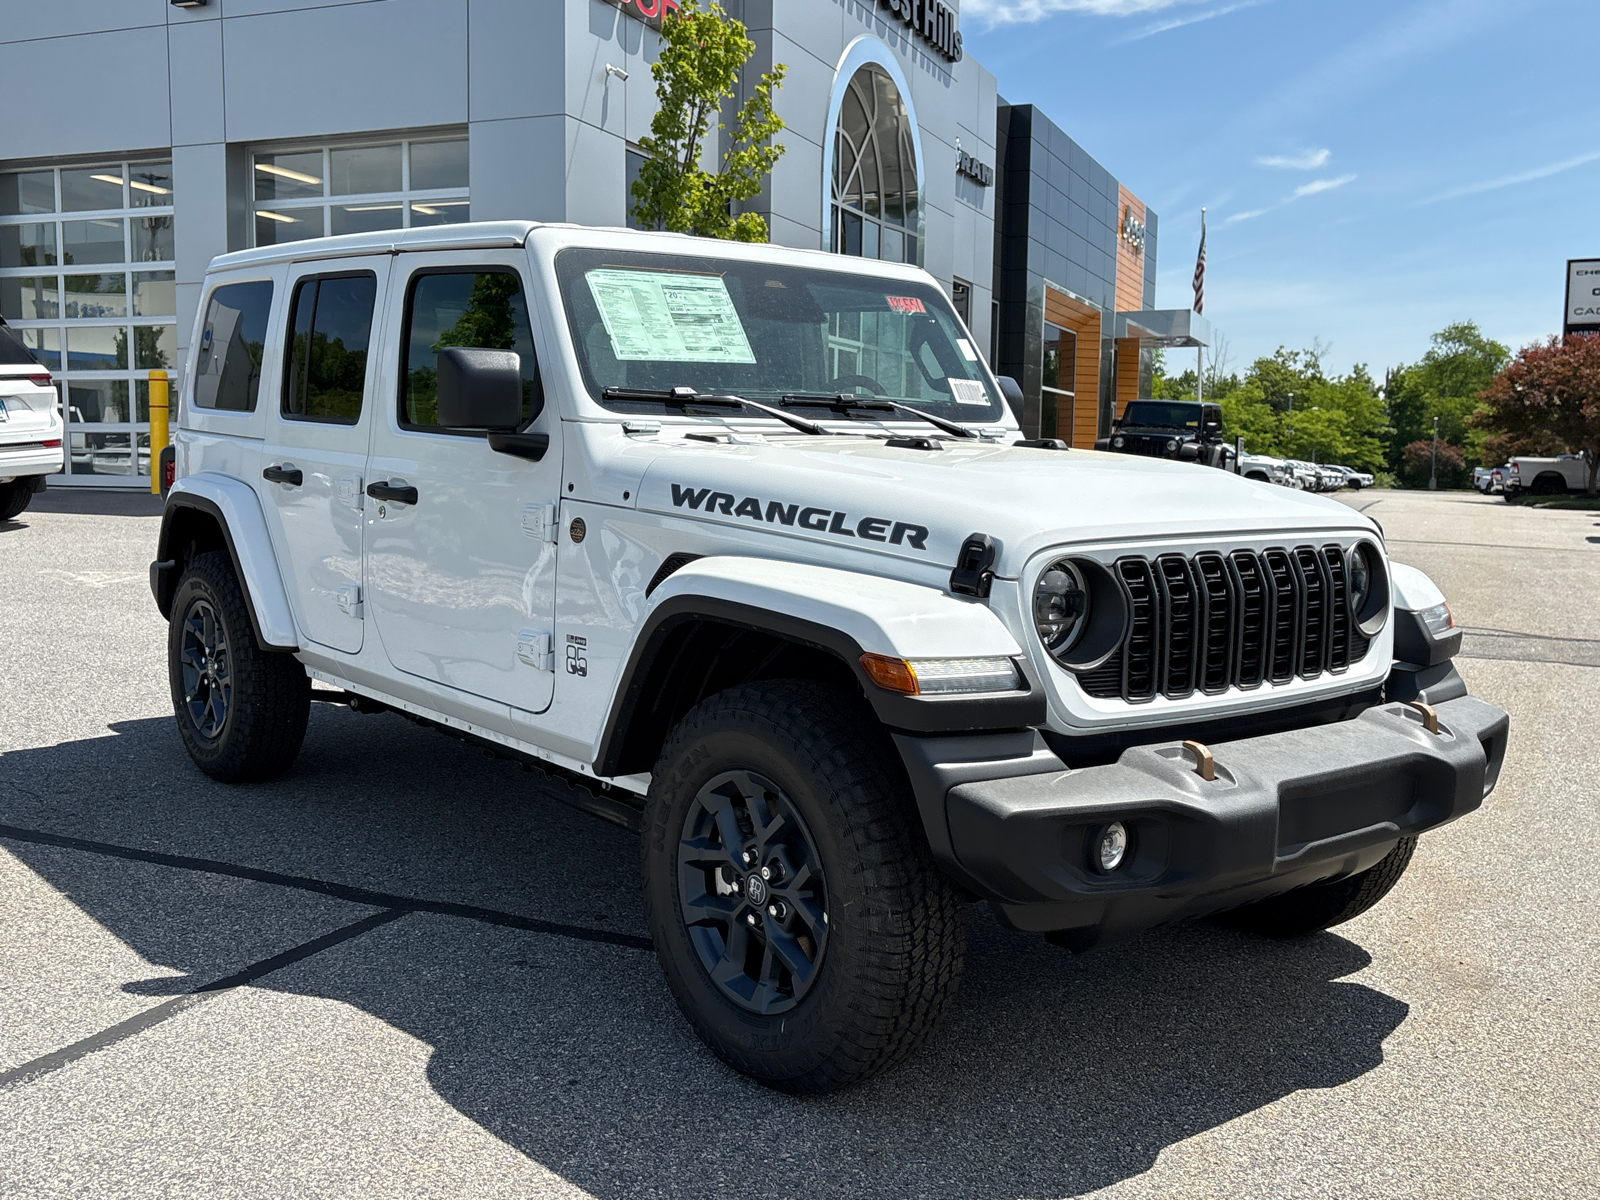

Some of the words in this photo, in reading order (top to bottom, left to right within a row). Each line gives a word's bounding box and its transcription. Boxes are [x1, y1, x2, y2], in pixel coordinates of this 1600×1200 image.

[924, 0, 963, 63] Hills
[961, 149, 993, 187] RAM
[670, 483, 930, 551] WRANGLER
[566, 644, 588, 677] 85
